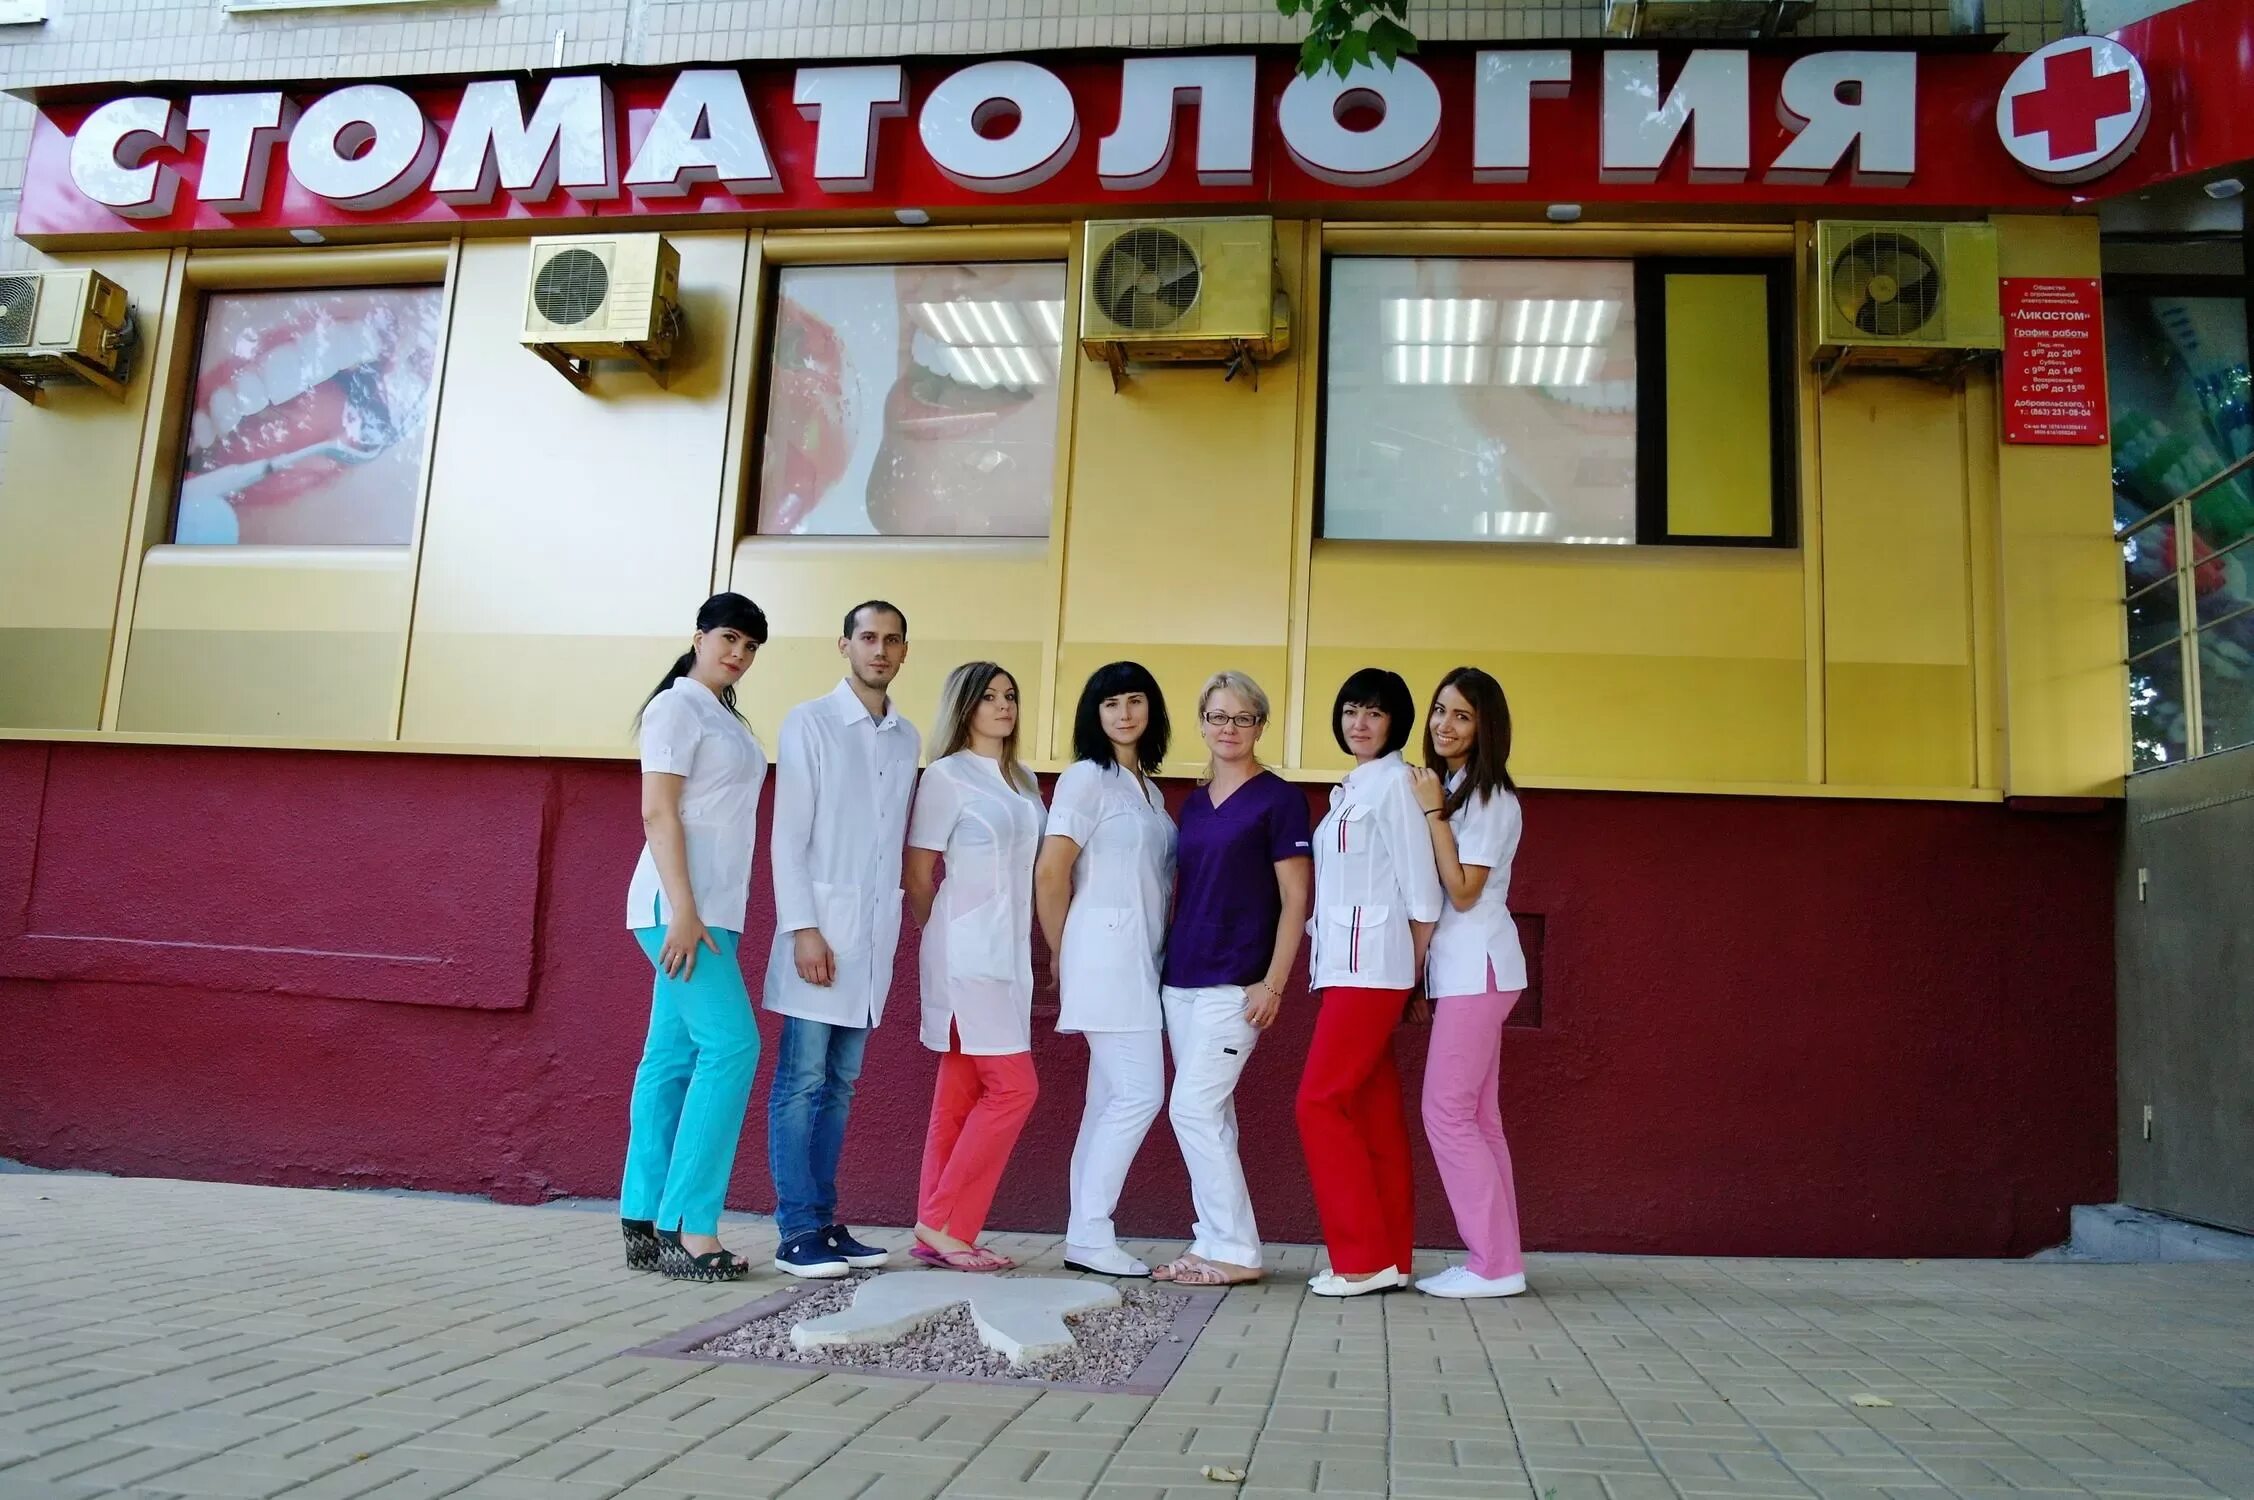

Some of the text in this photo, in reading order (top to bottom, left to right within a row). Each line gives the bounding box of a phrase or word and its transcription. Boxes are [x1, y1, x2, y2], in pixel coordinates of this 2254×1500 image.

[69, 50, 1918, 218] СТОМАТОЛОГИЯ
[2014, 328, 2089, 339] График работы
[2048, 368, 2061, 376] до
[2087, 400, 2095, 408] 11
[2030, 408, 2050, 416] (863)
